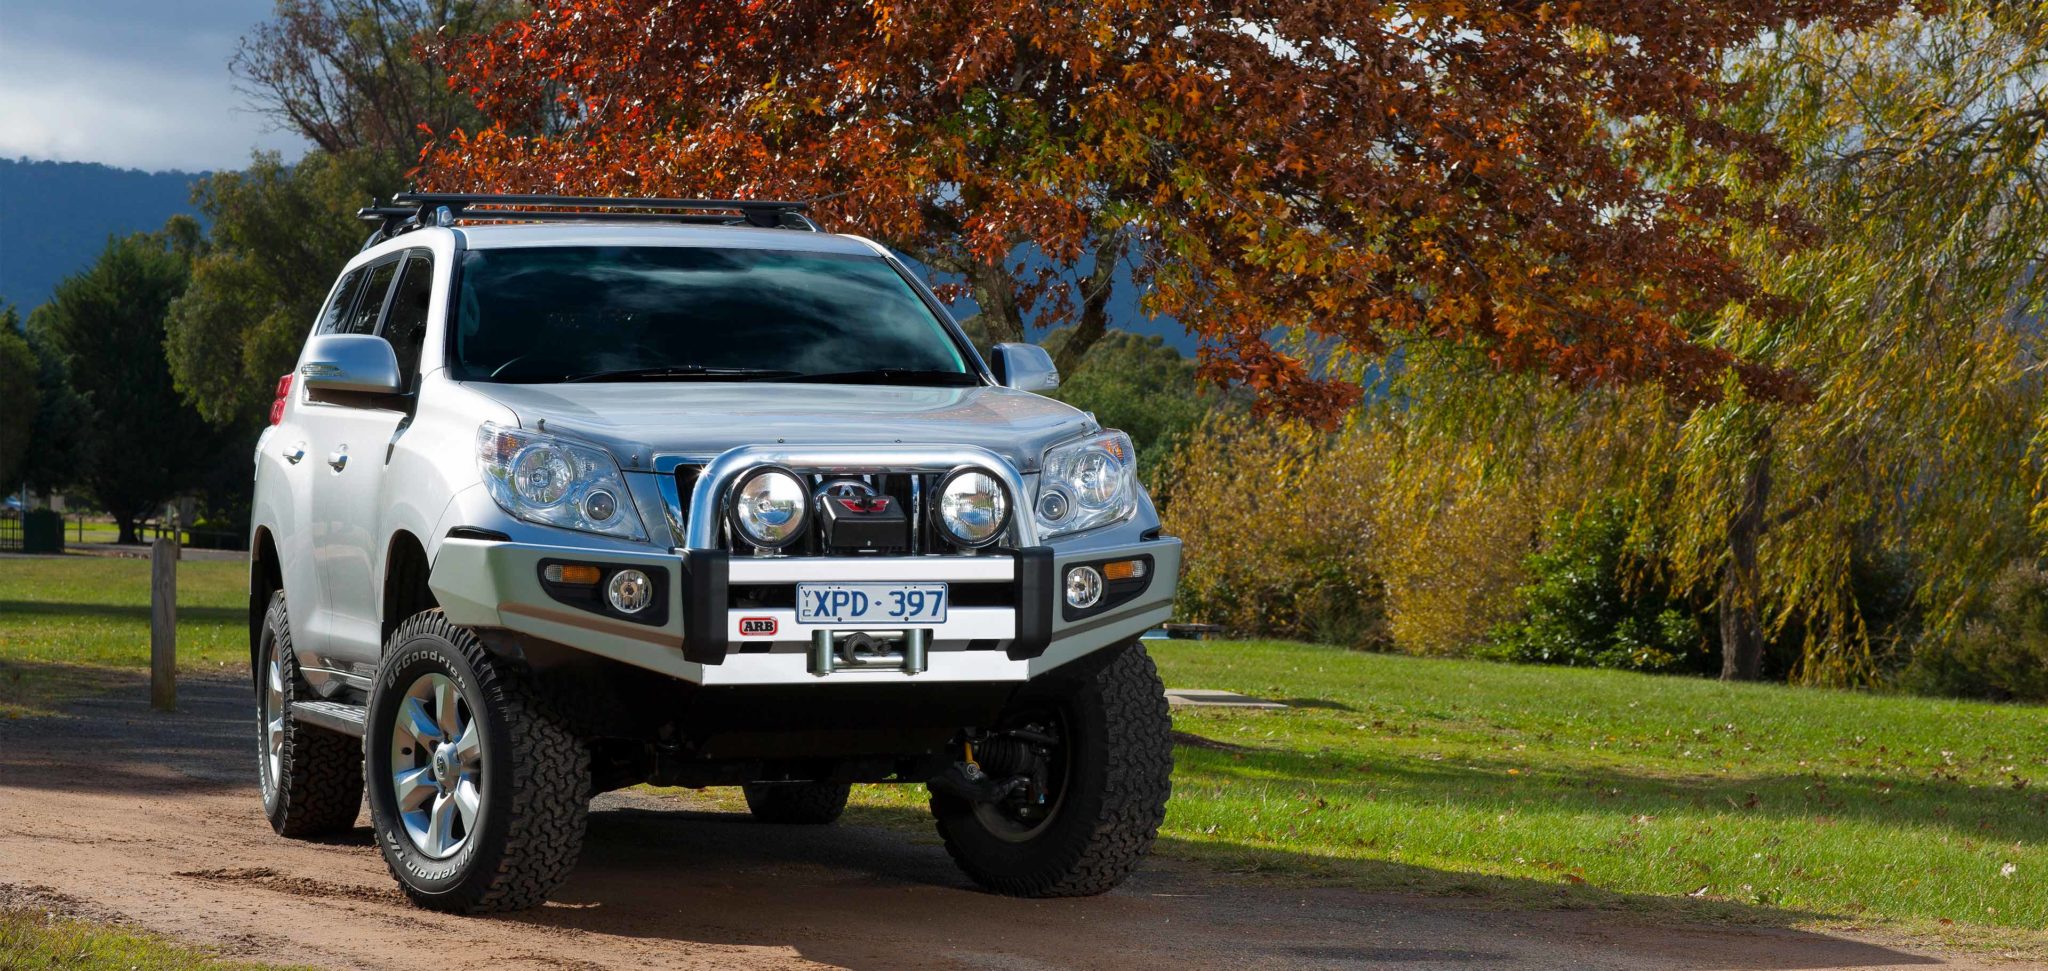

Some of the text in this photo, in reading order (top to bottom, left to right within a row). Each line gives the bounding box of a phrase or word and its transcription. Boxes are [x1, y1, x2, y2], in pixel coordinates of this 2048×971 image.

[803, 590, 811, 617] VIC
[743, 621, 774, 632] ARB
[387, 650, 467, 689] BFGoodrich
[386, 830, 405, 862] T/A
